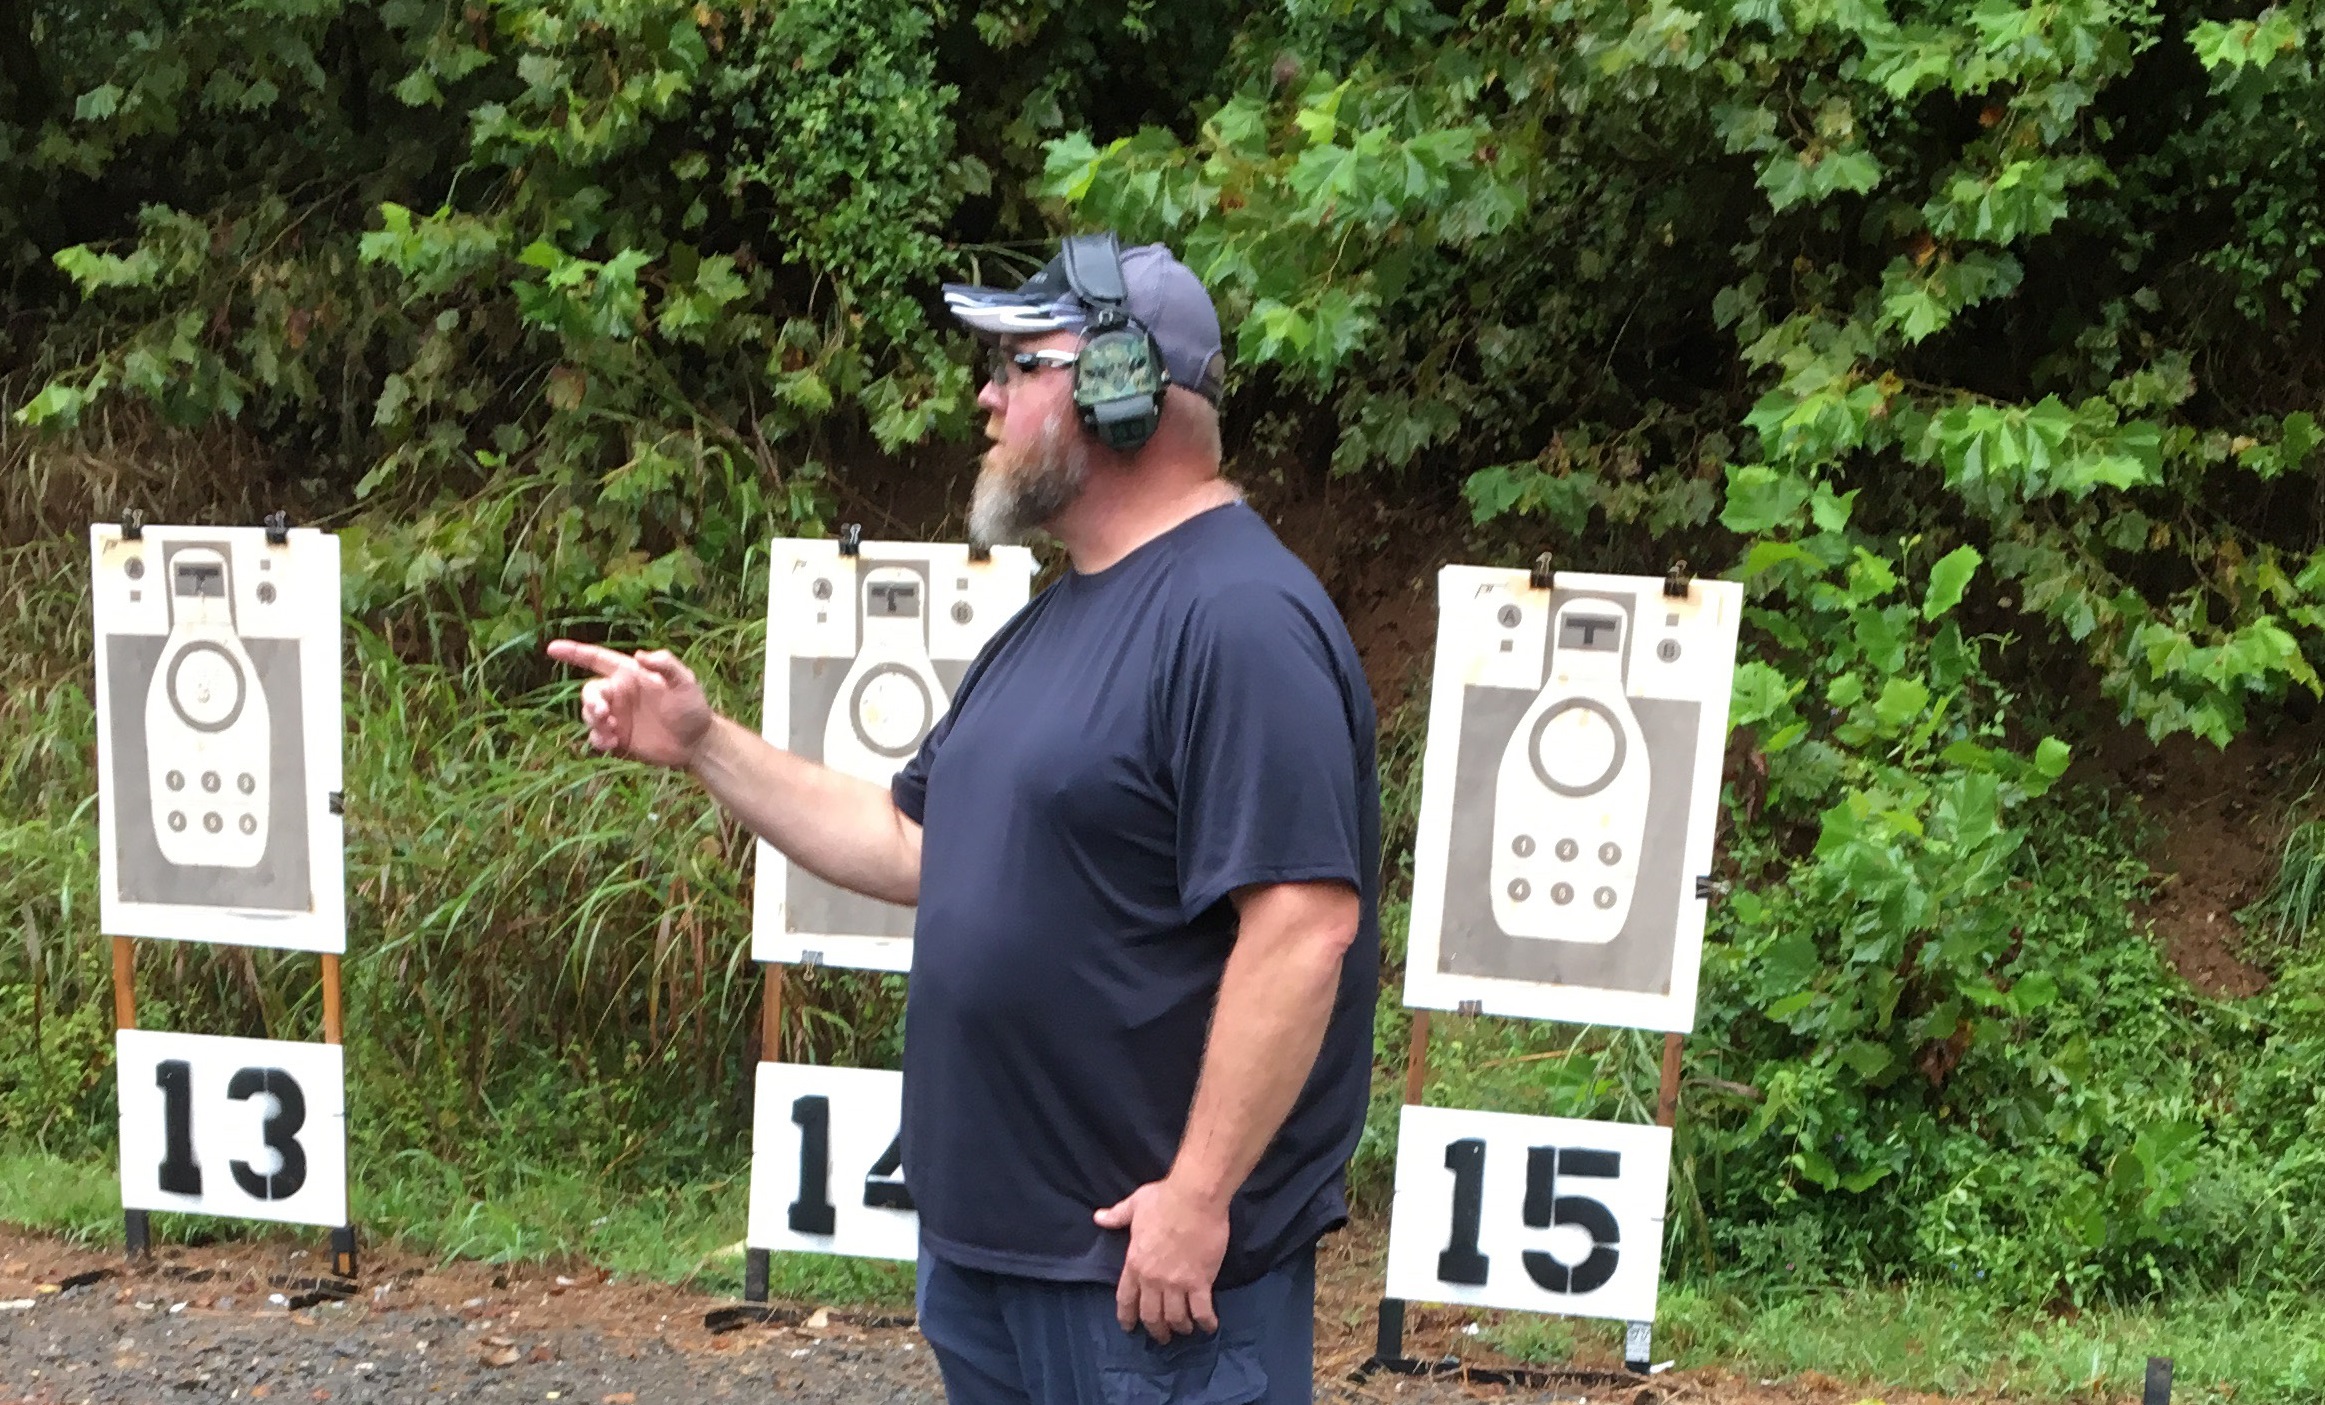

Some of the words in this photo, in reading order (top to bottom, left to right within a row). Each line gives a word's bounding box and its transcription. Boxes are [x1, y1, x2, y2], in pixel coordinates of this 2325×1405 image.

[1503, 609, 1516, 625] A
[155, 1059, 308, 1202] 13
[1437, 1137, 1621, 1294] 15
